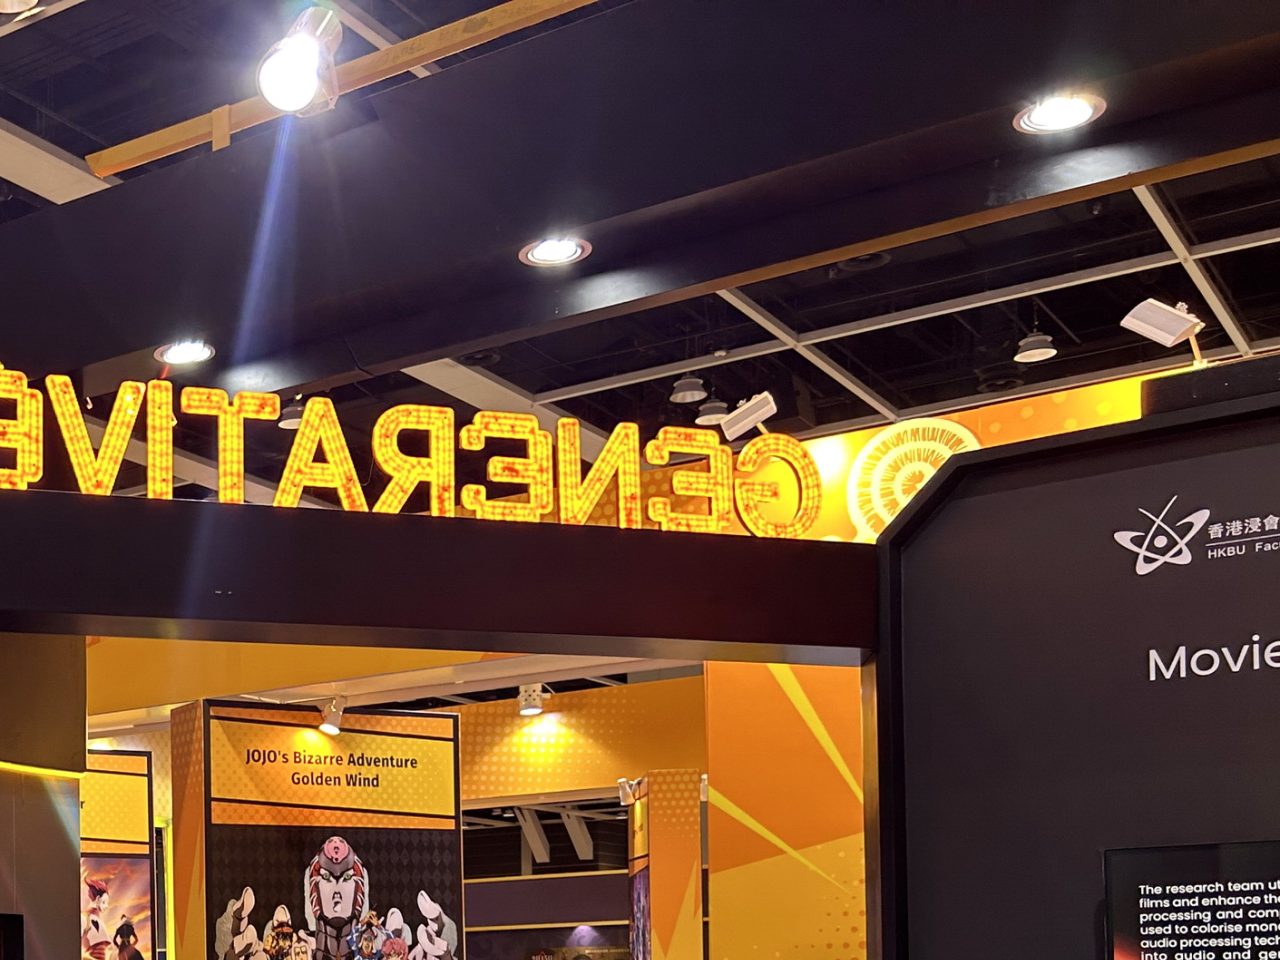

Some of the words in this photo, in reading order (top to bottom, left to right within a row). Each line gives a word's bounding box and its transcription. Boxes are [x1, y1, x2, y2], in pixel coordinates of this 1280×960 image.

[1207, 545, 1247, 560] HKBU
[1148, 633, 1280, 682] Movie
[246, 748, 289, 765] JOJO's
[293, 750, 343, 766] Bizarre
[347, 753, 418, 768] Adventure
[291, 771, 341, 786] Golden
[345, 773, 380, 788] Wind
[1138, 885, 1162, 895] The
[1165, 881, 1224, 893] research
[1227, 881, 1264, 892] team
[1139, 898, 1170, 908] films
[1172, 896, 1199, 907] and
[1201, 894, 1261, 906] enhance
[1139, 909, 1212, 925] processing
[1216, 908, 1243, 920] and
[1140, 924, 1172, 935] used
[1174, 924, 1188, 934] to
[1190, 922, 1243, 934] colorise
[1140, 937, 1178, 948] audio
[1179, 935, 1252, 951] processing
[1174, 950, 1216, 960] audio
[1222, 949, 1251, 960] and
